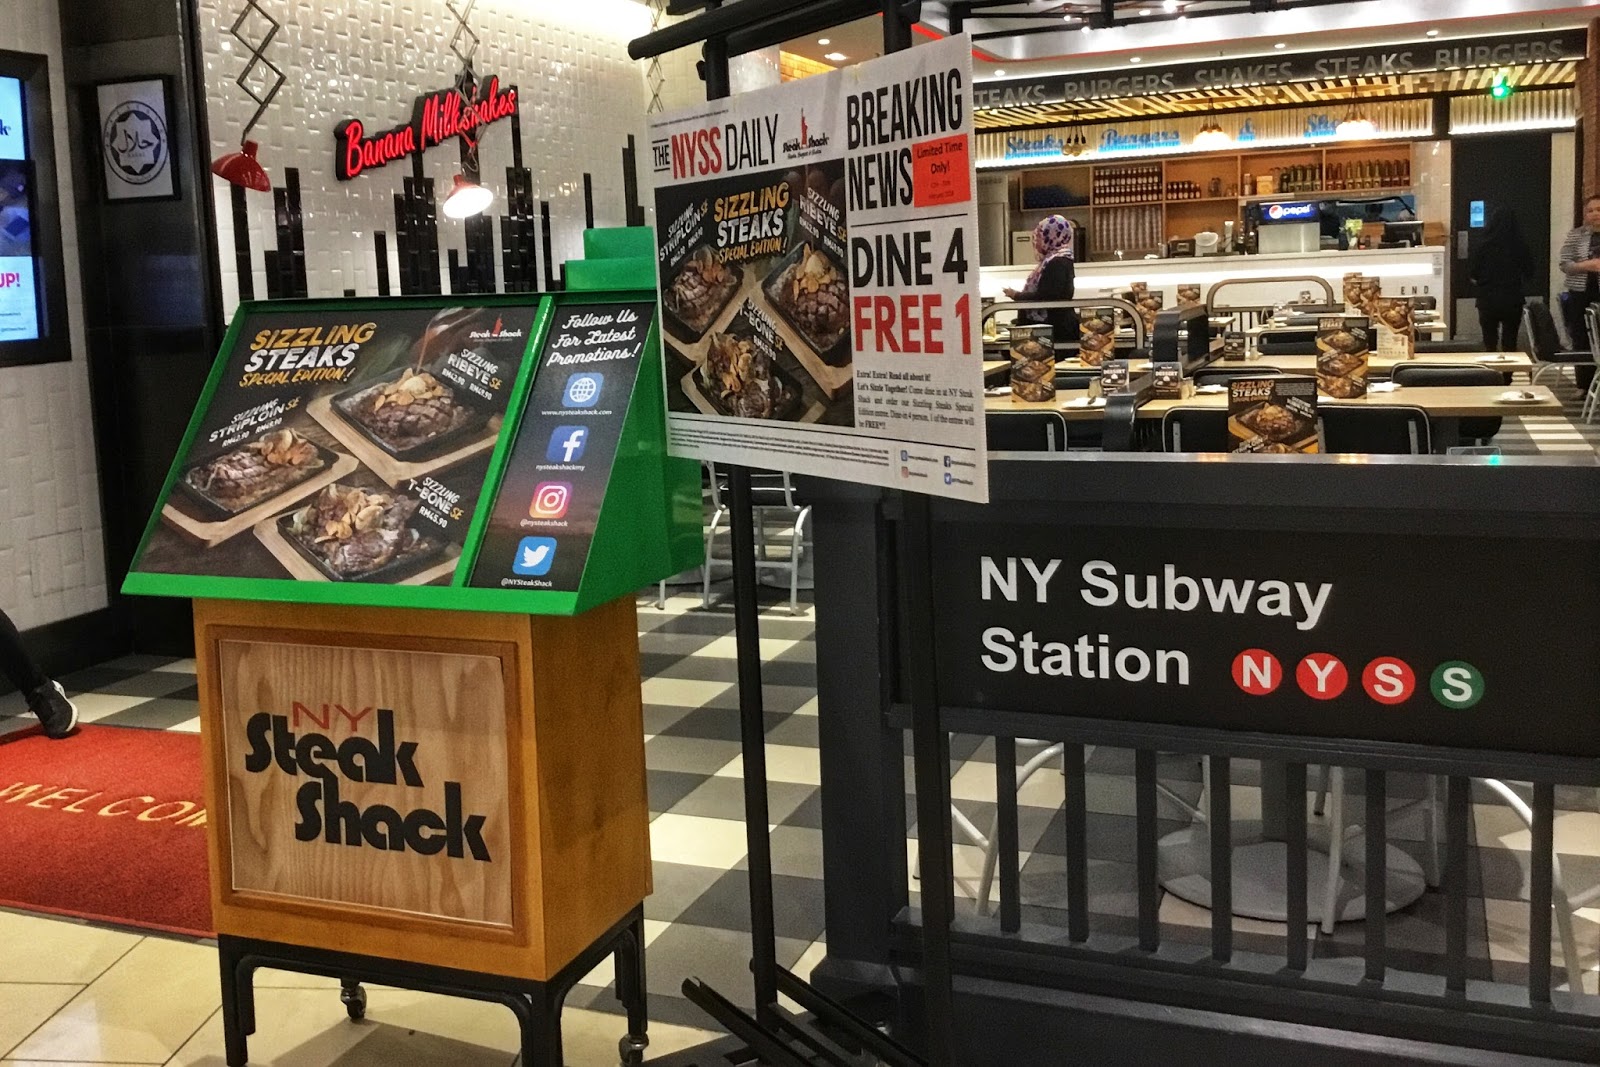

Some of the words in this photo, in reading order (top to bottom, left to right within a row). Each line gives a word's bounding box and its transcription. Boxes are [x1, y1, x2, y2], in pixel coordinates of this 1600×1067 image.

[974, 84, 1046, 108] TEAKS
[1064, 72, 1174, 101] BURGERS
[1194, 61, 1293, 87] SHAKES
[1314, 51, 1413, 78] STEAKS
[1435, 38, 1563, 70] BURGERS
[846, 67, 962, 150] BREAKING
[345, 121, 416, 177] Banana
[652, 144, 670, 167] THE
[671, 126, 722, 179] NYSS
[725, 113, 779, 172] DAILY
[916, 143, 943, 159] Limited
[944, 142, 962, 153] Time
[848, 147, 913, 212] NEWS
[930, 160, 950, 175] Only!
[714, 182, 789, 222] SIZZLING
[806, 187, 840, 221] SIZZLING
[1282, 203, 1312, 216] pepsi
[659, 208, 701, 261] STRIPLOIN
[716, 208, 784, 247] STEAKS
[719, 244, 749, 264] SPECIAL
[851, 230, 933, 288] DINE
[942, 227, 968, 284] 4
[562, 313, 613, 329] Follow
[616, 309, 639, 323] Us
[853, 294, 944, 354] FREE
[955, 293, 971, 354] 1
[250, 322, 377, 350] SIZZLING
[552, 333, 582, 348] For
[584, 326, 636, 346] Latest
[244, 343, 360, 372] STEAKS
[461, 348, 499, 374] SIZZLING
[546, 342, 642, 367] Promotions!
[239, 371, 290, 387] SPECIAL
[292, 367, 356, 382] EDITION!
[447, 353, 491, 385] RIBEYE
[489, 377, 502, 390] SE
[856, 370, 872, 378] Extra!
[872, 370, 888, 380] Extra!
[889, 372, 902, 380] Read
[910, 373, 924, 382] about
[1231, 380, 1275, 390] SIZZLING
[948, 388, 958, 397] NY
[1232, 388, 1271, 398] STEAKS
[541, 409, 613, 417] www.nysteakshack.com
[956, 402, 974, 413] Special
[208, 403, 286, 442] STRIPLOIN
[535, 464, 586, 472] nysteakshackmy
[408, 478, 453, 515] T-BONE
[450, 506, 464, 520] SE
[422, 476, 460, 504] SIZZLING
[418, 505, 448, 528] RM45.90
[520, 518, 568, 528] @nysteakshack
[500, 578, 553, 588] @NYSteakShack
[980, 556, 1062, 603] NY
[1079, 558, 1333, 631] Subway
[981, 626, 1190, 685] Station
[1241, 654, 1272, 689] N
[1305, 658, 1337, 693] Y
[1372, 662, 1405, 698] S
[1441, 666, 1473, 702] S
[292, 701, 373, 732] NY
[245, 709, 425, 788] Steak
[294, 771, 492, 862] Shack
